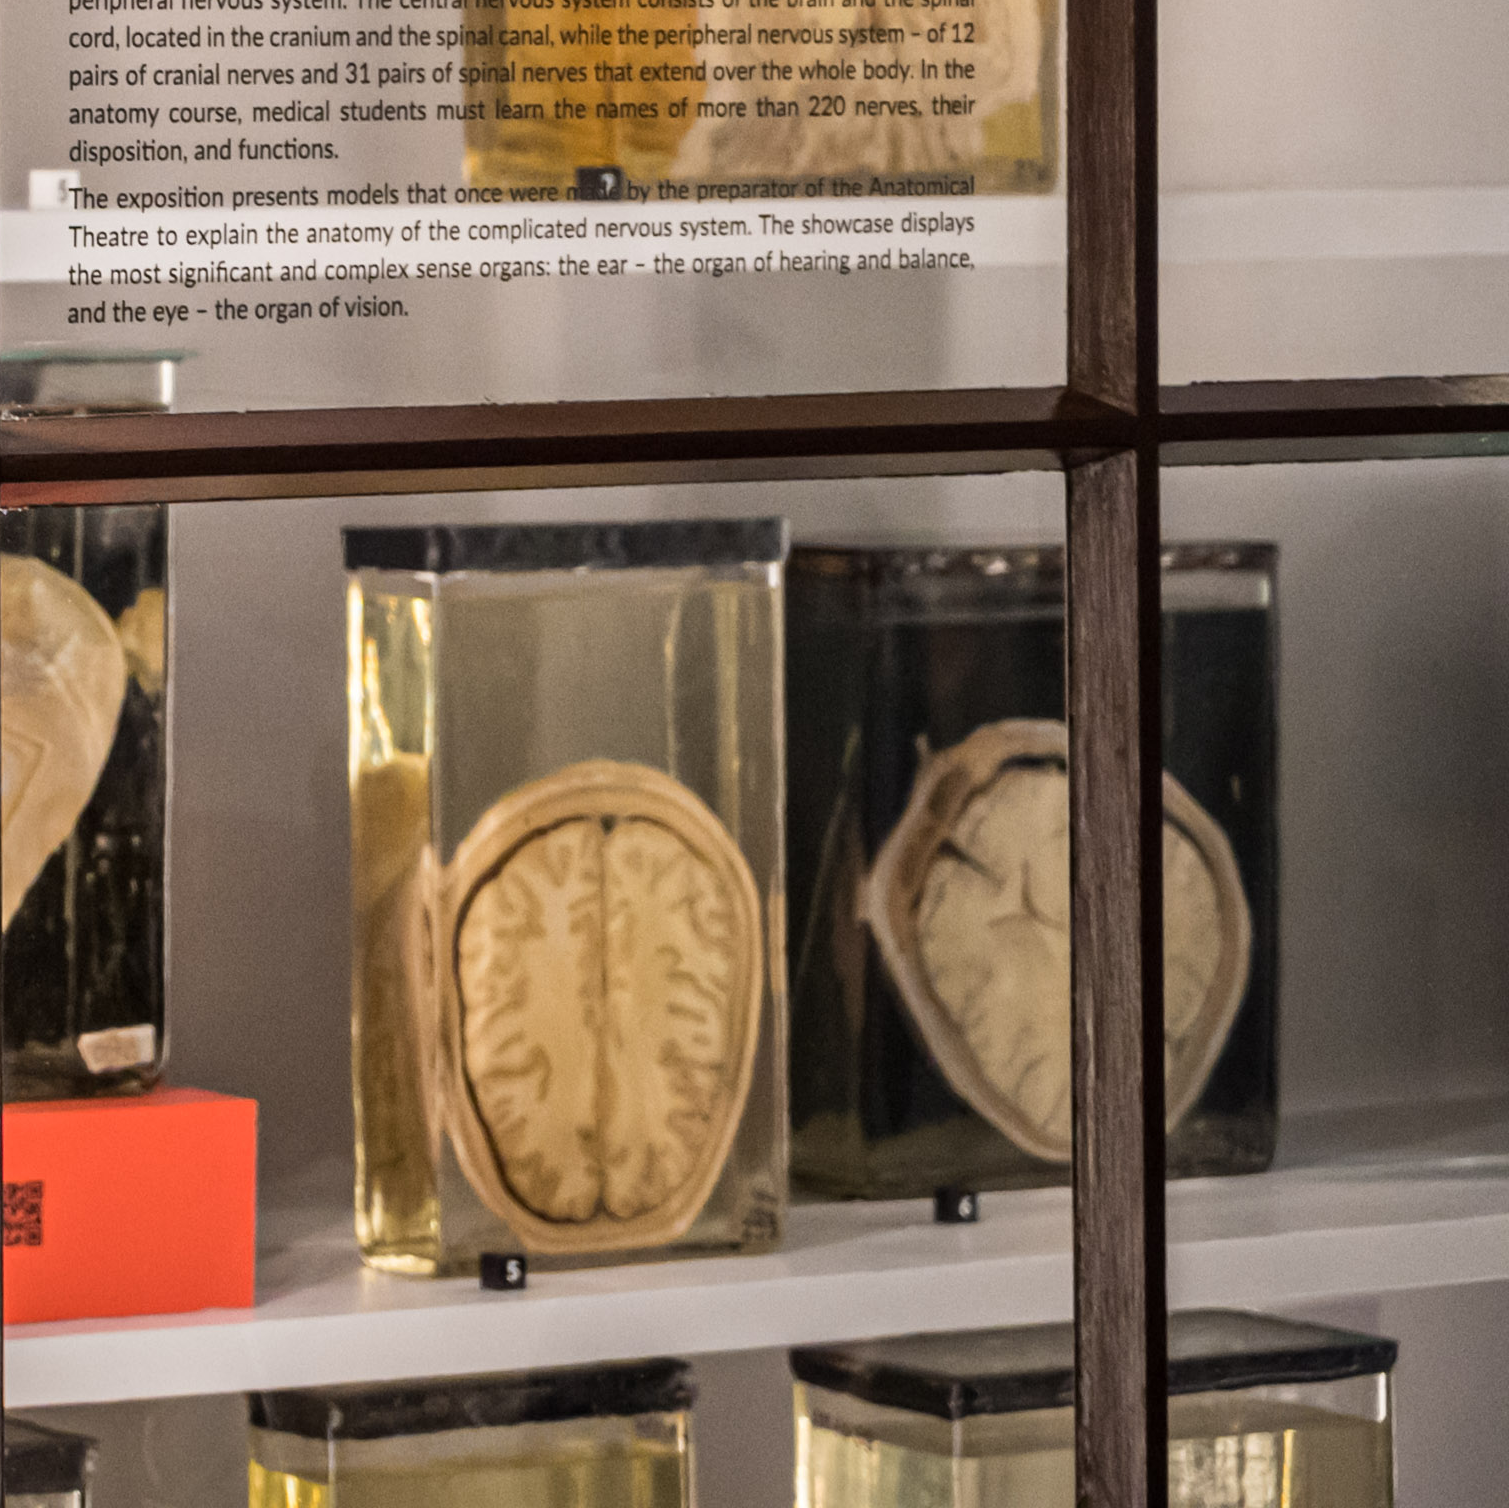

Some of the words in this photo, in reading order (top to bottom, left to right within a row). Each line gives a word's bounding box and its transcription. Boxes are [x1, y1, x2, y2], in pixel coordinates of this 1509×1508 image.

[68, 25, 120, 51] cord,
[125, 24, 202, 49] located
[206, 24, 226, 48] in
[230, 24, 265, 48] the
[269, 24, 351, 48] cranium
[355, 23, 393, 47] and
[397, 23, 432, 47] the
[951, 21, 975, 44] 12
[68, 63, 119, 92] pairs
[125, 63, 148, 87] of
[152, 62, 220, 87] cranial
[227, 67, 295, 86] nerves
[300, 61, 339, 85] and
[344, 61, 371, 85] 31
[377, 61, 426, 89] pairs
[431, 60, 454, 84] of
[68, 103, 161, 129] anatomy
[168, 106, 243, 126] course,
[252, 99, 330, 123] medical
[339, 98, 427, 123] students
[68, 138, 188, 167] disposition,
[193, 137, 232, 161] and
[237, 136, 339, 161] functions.
[68, 186, 109, 210] The
[116, 185, 224, 214] exposition
[232, 186, 320, 212] presents
[326, 182, 400, 206] models
[406, 181, 448, 205] that
[67, 225, 149, 248] Theatre
[156, 226, 178, 247] to
[185, 222, 259, 250] explain
[265, 221, 300, 245] the
[306, 223, 395, 247] anatomy
[400, 219, 422, 243] of
[427, 219, 461, 242] the
[467, 216, 588, 245] complicated
[594, 221, 673, 239] nervous
[679, 217, 753, 241] system.
[757, 213, 795, 236] The
[801, 212, 894, 236] showcase
[900, 210, 975, 237] displays
[67, 262, 103, 287] the
[110, 263, 162, 285] most
[168, 259, 274, 289] significant
[279, 258, 317, 283] and
[323, 257, 409, 285] complex
[416, 261, 472, 280] sense
[478, 259, 551, 283] organs:
[557, 253, 590, 277] the
[596, 258, 629, 276] ear
[652, 251, 685, 275] the
[67, 300, 107, 324] and
[112, 299, 147, 324] the
[152, 304, 190, 327] eye
[214, 297, 249, 321] the
[254, 301, 313, 325] organ
[318, 295, 341, 319] of
[506, 1259, 521, 1283] 5
